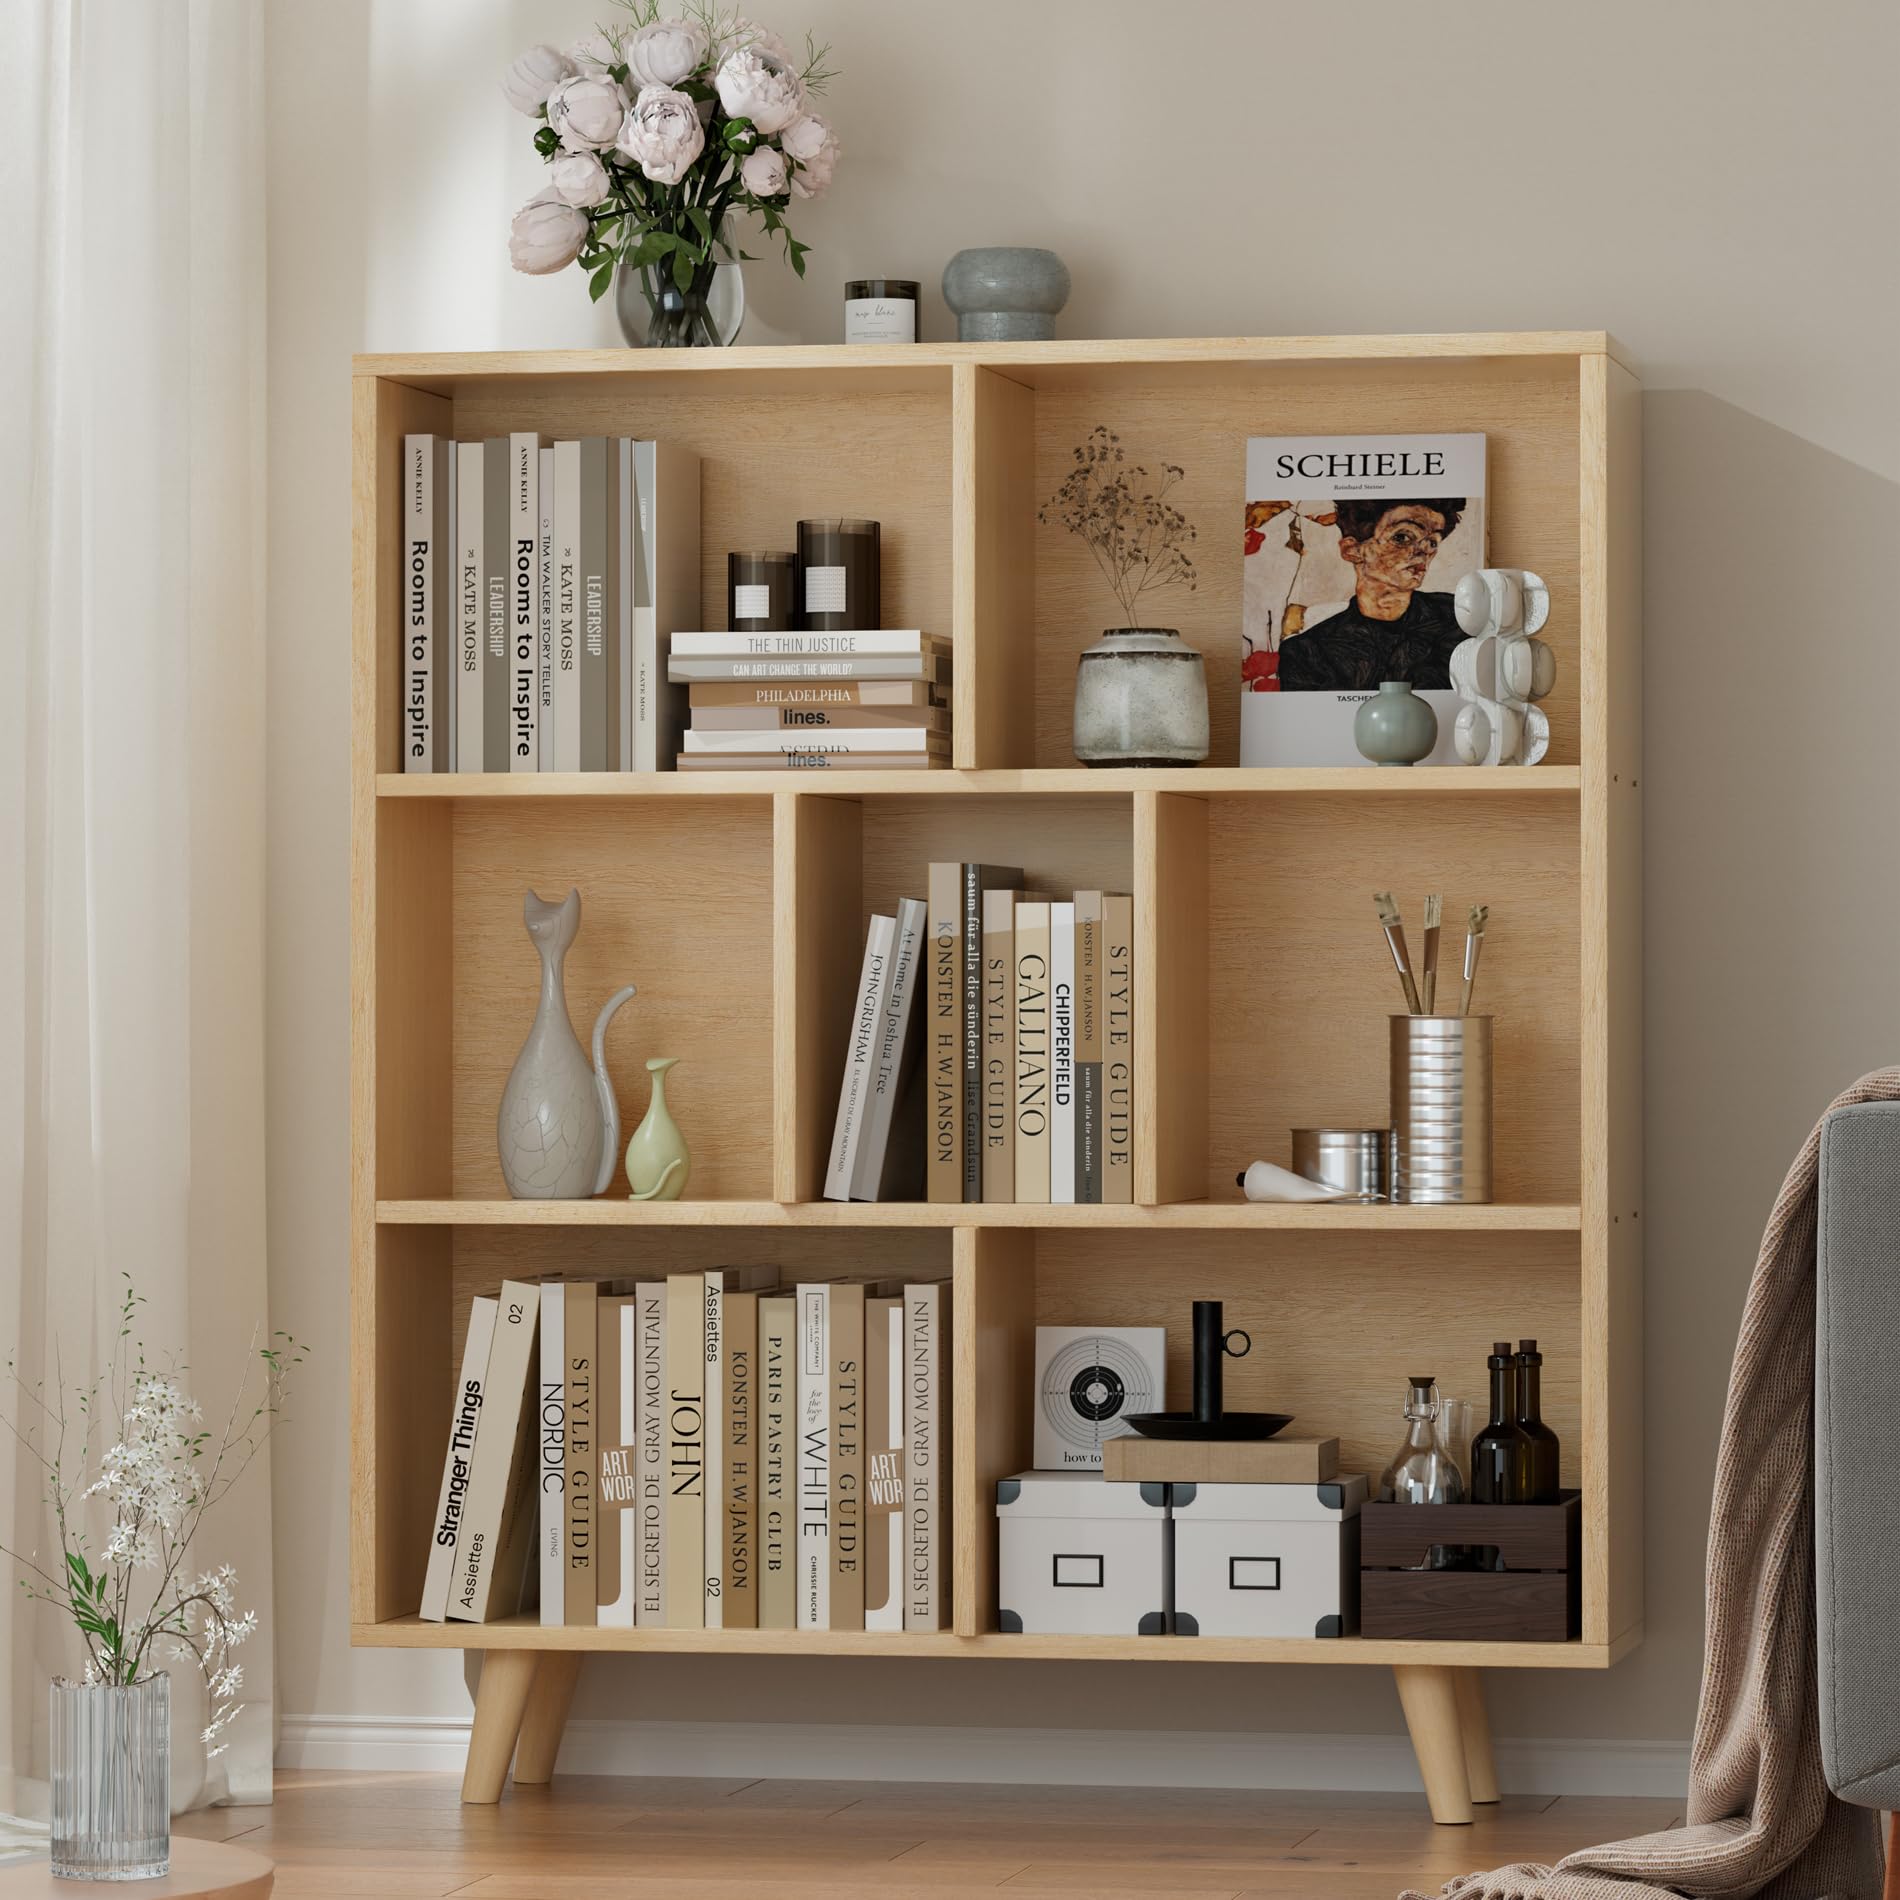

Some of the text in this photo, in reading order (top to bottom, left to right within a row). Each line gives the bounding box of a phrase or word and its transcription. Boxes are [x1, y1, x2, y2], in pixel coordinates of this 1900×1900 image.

[415, 448, 423, 514] ANNIE KELLY
[520, 446, 528, 513] ANNIE KELLY
[1276, 452, 1445, 479] SCHIELE
[407, 541, 429, 757] Rooms to Inspire
[464, 565, 476, 672] KATE MOSS
[489, 576, 504, 657] LEADERSHIP
[512, 539, 534, 757] Rooms to Inspire
[542, 535, 551, 707] TIM WALKER STORY TELLER
[561, 563, 573, 671] KATE MOSS
[587, 575, 602, 656] LEADERSHIP
[748, 637, 857, 653] THE THIN JUSTICE
[733, 663, 853, 676] CAN ART CHANGE THE WORLD?
[756, 689, 851, 702] PHILADELPHIA
[783, 709, 831, 725] lines.
[787, 752, 831, 767] lines.
[967, 872, 976, 911] saum
[967, 917, 980, 938] für
[937, 921, 954, 1017] KONSTEN
[967, 944, 980, 970] alla
[1084, 916, 1093, 967] KONSTEN
[877, 929, 916, 1095] At Home in Joshua Tree
[967, 976, 980, 999] die
[967, 1003, 980, 1069] sünderin
[988, 959, 1004, 1148] STYLE GUIDE
[1018, 954, 1046, 1136] GALLIANO
[1055, 984, 1070, 1106] CHIPPERFIELD
[1109, 946, 1128, 1166] STYLE GUIDE
[508, 1304, 523, 1324] 02
[707, 1285, 721, 1362] Assiettes
[542, 1384, 565, 1493] NORDIC
[732, 1352, 747, 1446] KONSTEN
[437, 1380, 483, 1547] Stranger Things
[572, 1358, 589, 1569] STYLE GUIDE
[603, 1450, 628, 1476] ART
[644, 1299, 660, 1611] EL SECRETO DE GRAY MOUNTAIN
[671, 1389, 701, 1496] JOHN
[767, 1337, 782, 1571] PARIS PASTRY CLUB
[803, 1428, 828, 1536] WHITE
[838, 1361, 856, 1573] STYLE GUIDE
[871, 1453, 897, 1480] ART
[913, 1301, 929, 1616] EL SECRETO DE GRAY MOUNTAIN
[1064, 1451, 1102, 1463] how to
[460, 1533, 485, 1609] Assiettes
[550, 1528, 558, 1558] LIVING
[707, 1577, 721, 1597] 02
